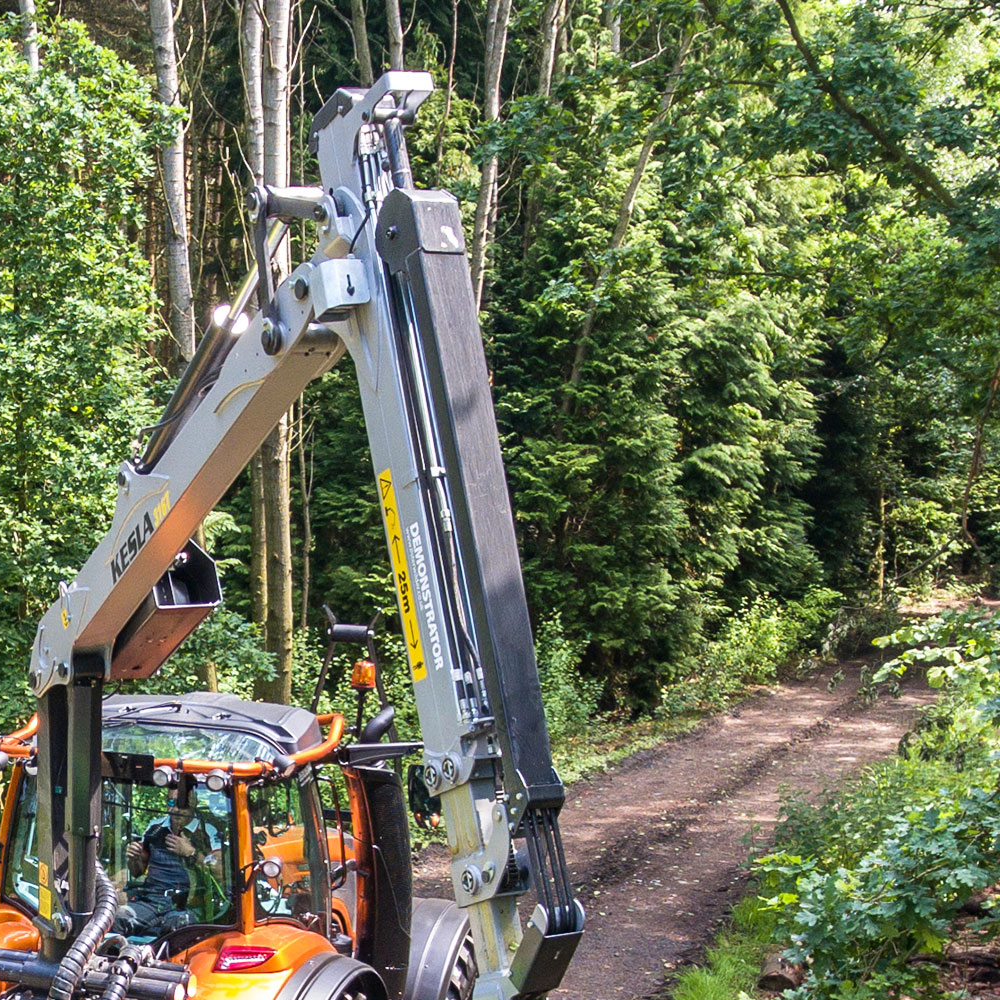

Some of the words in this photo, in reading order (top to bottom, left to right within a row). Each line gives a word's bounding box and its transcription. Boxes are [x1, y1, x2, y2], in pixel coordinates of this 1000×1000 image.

[110, 512, 154, 584] KESLA
[397, 570, 411, 614] 25m
[409, 521, 444, 671] DEMONSTRATOR
